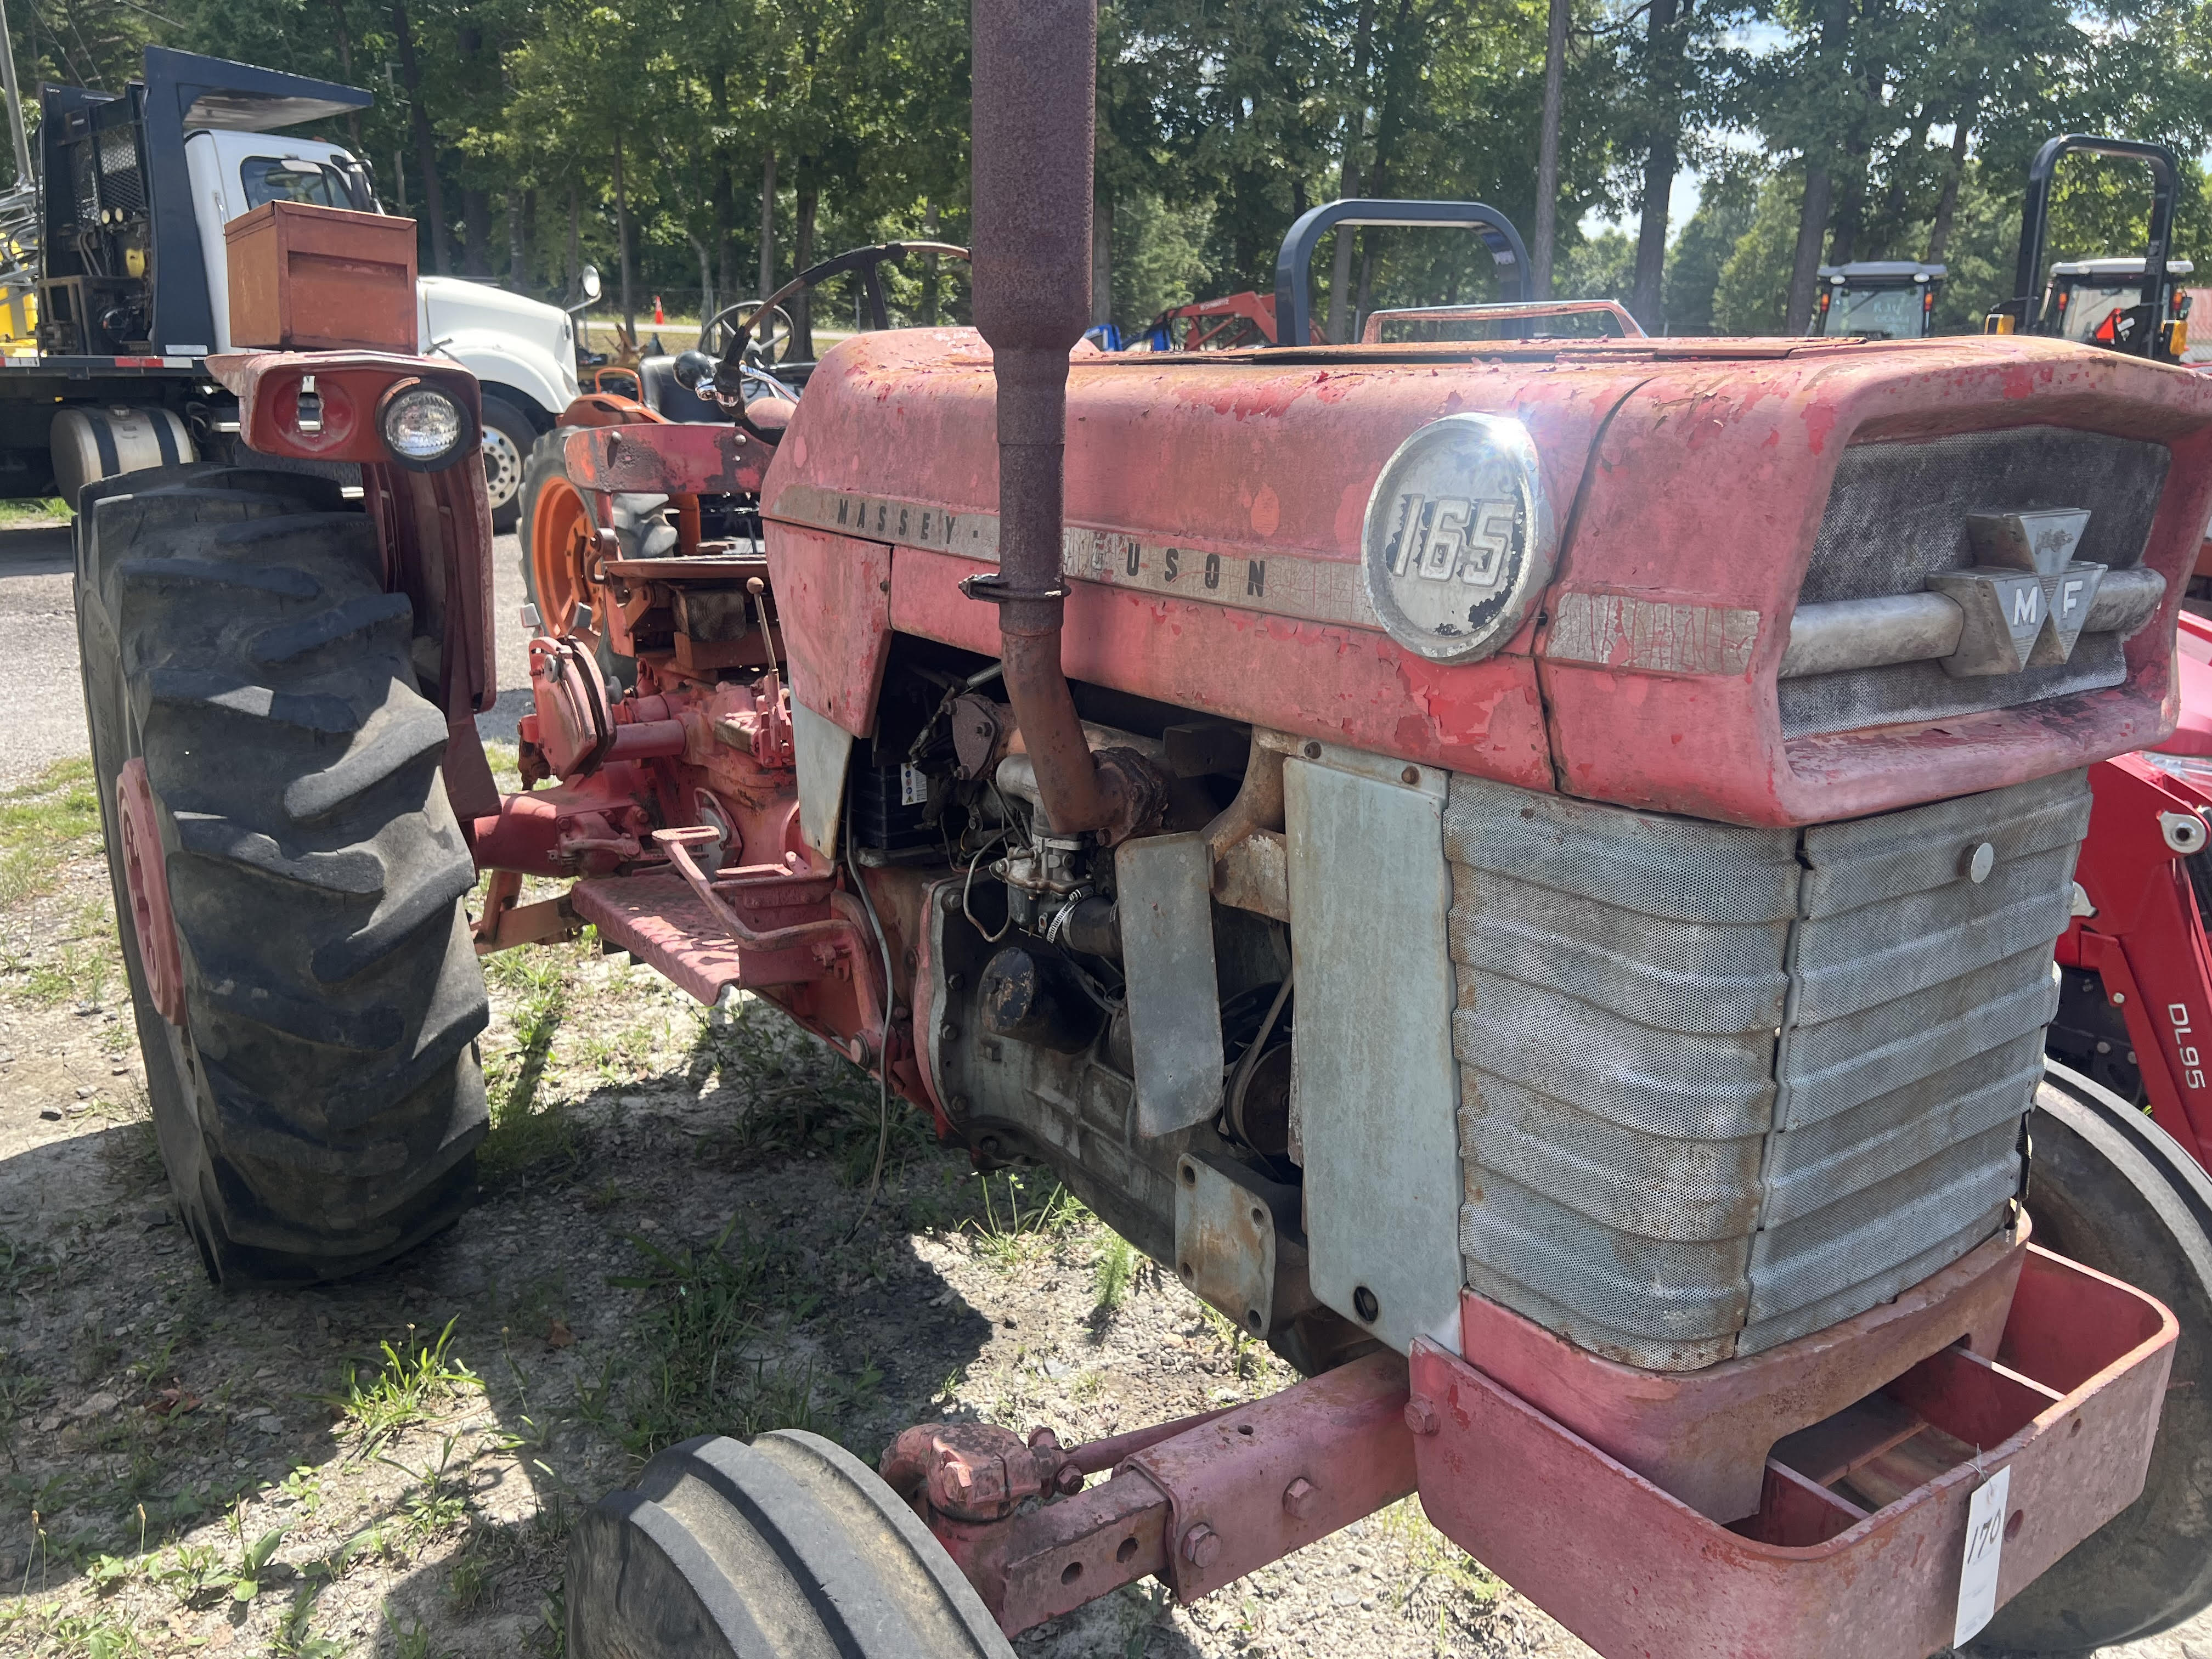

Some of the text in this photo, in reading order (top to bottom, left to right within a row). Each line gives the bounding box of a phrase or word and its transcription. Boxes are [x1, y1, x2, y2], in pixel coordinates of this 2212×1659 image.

[1392, 494, 1518, 588] 165
[2168, 1003, 2205, 1088] DL95
[1967, 1509, 2001, 1564] 170
